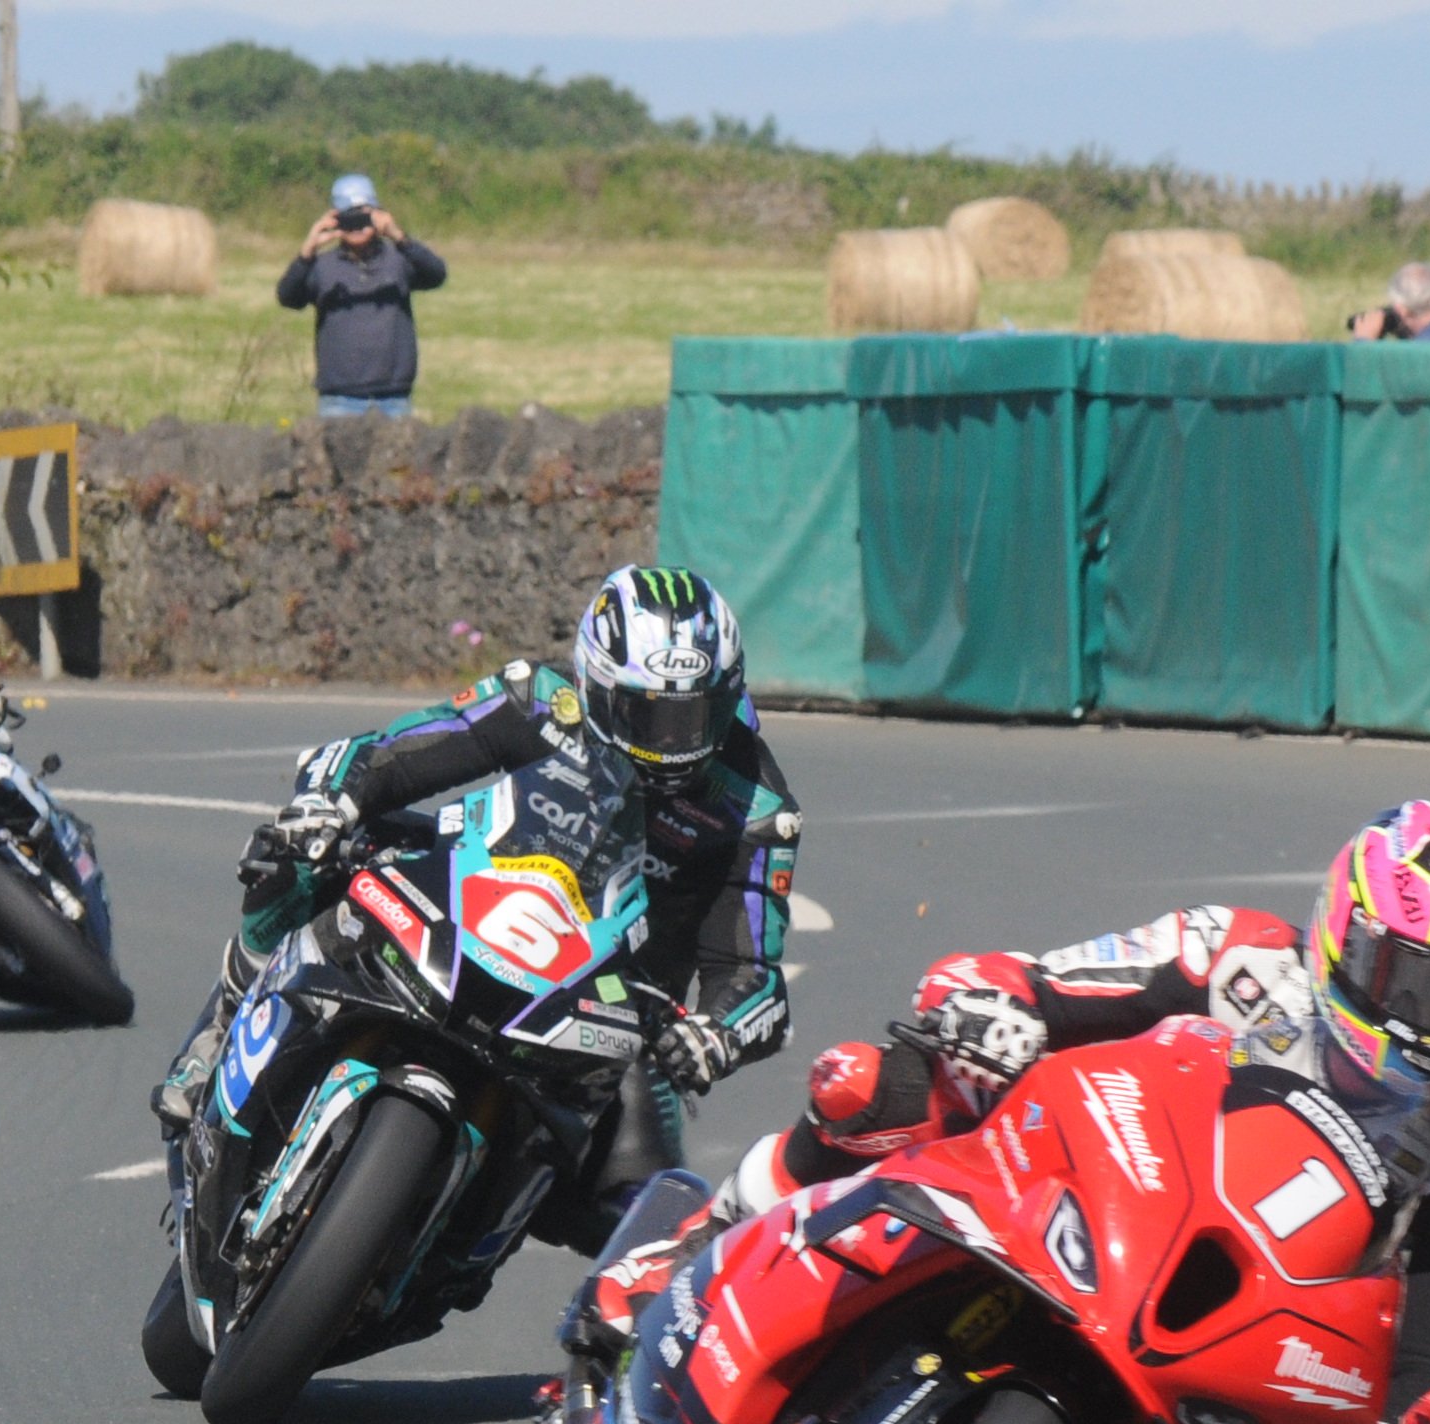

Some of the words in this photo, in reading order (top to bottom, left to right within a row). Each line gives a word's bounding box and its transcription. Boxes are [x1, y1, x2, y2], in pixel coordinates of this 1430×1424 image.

[652, 654, 700, 670] Arai
[356, 877, 413, 931] Crendon
[497, 860, 551, 871] STEAM
[553, 868, 589, 920] PACKET
[476, 890, 575, 970] 6
[597, 1032, 635, 1053] Druck
[1089, 1066, 1167, 1193] Milwaukee
[1252, 1157, 1349, 1242] 1
[1276, 1333, 1374, 1400] Milwaukee
